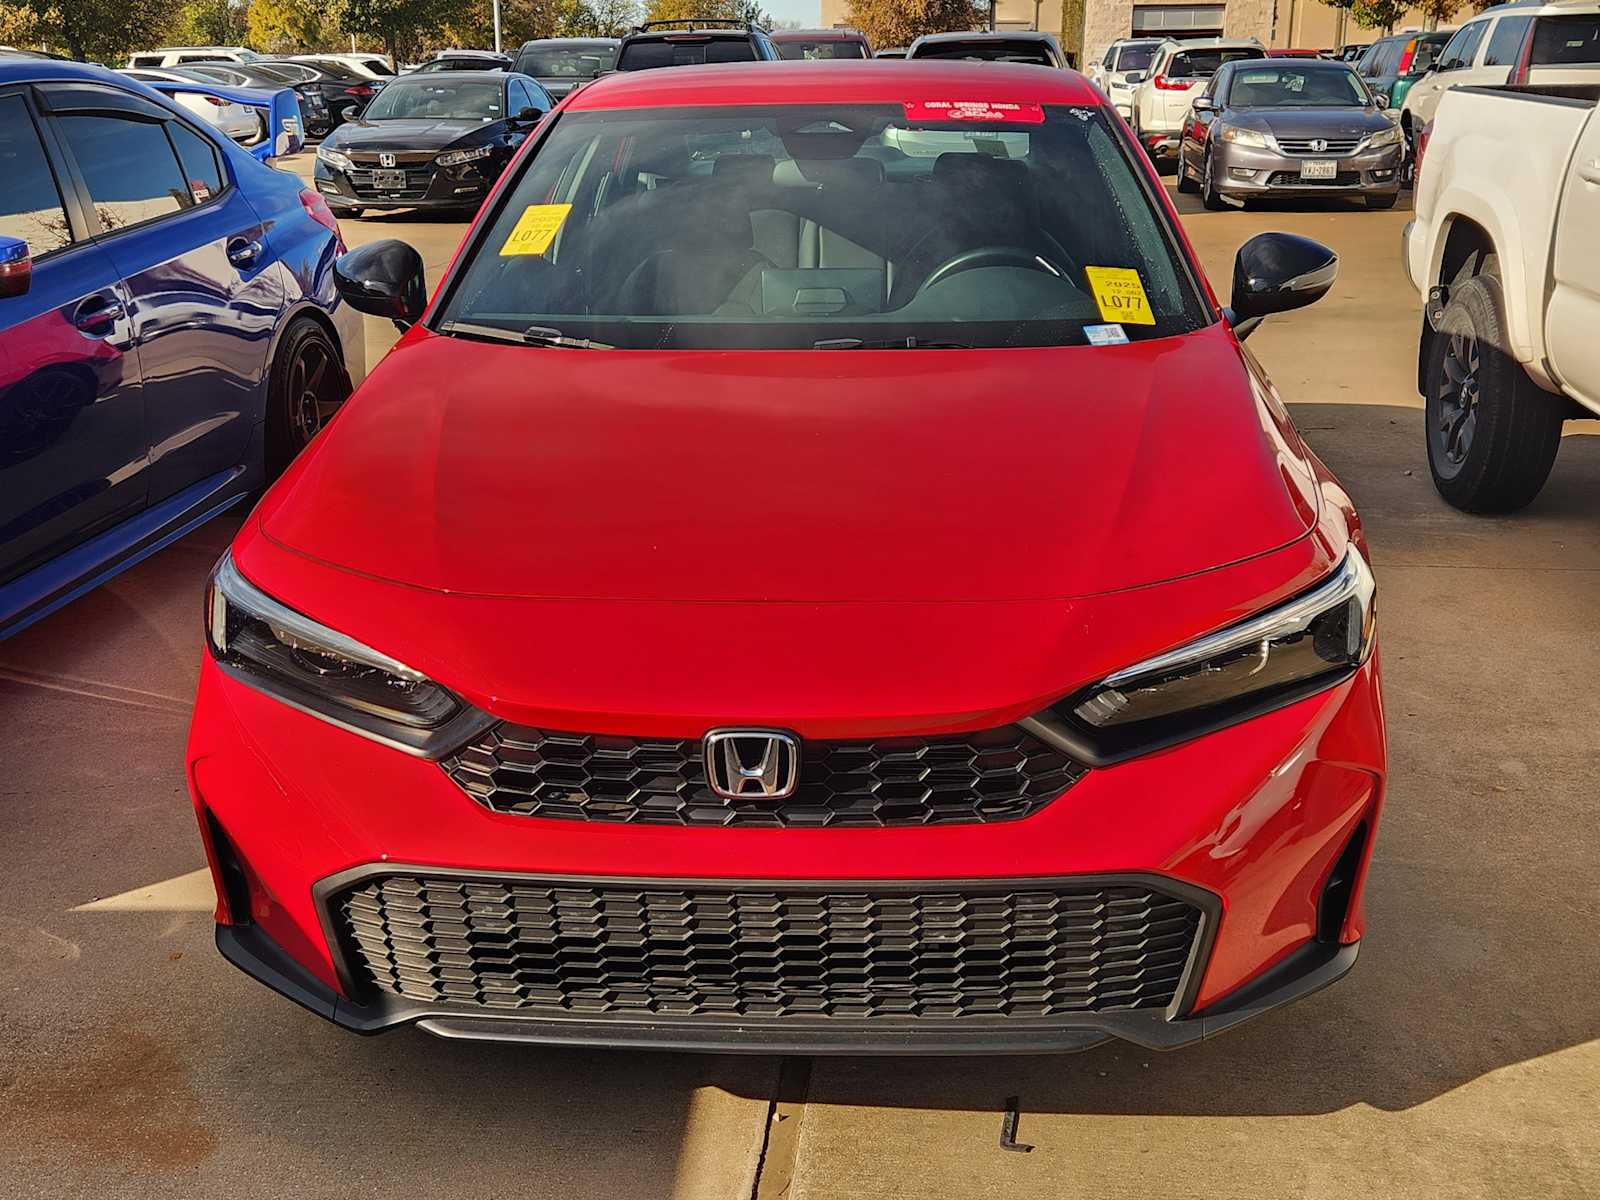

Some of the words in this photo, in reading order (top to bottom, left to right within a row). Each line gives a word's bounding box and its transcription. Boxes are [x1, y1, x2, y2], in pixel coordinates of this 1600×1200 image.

[924, 101, 952, 109] CORAL
[953, 101, 989, 109] SPRINGS
[991, 103, 1020, 111] HONDA
[1101, 295, 1142, 309] L077
